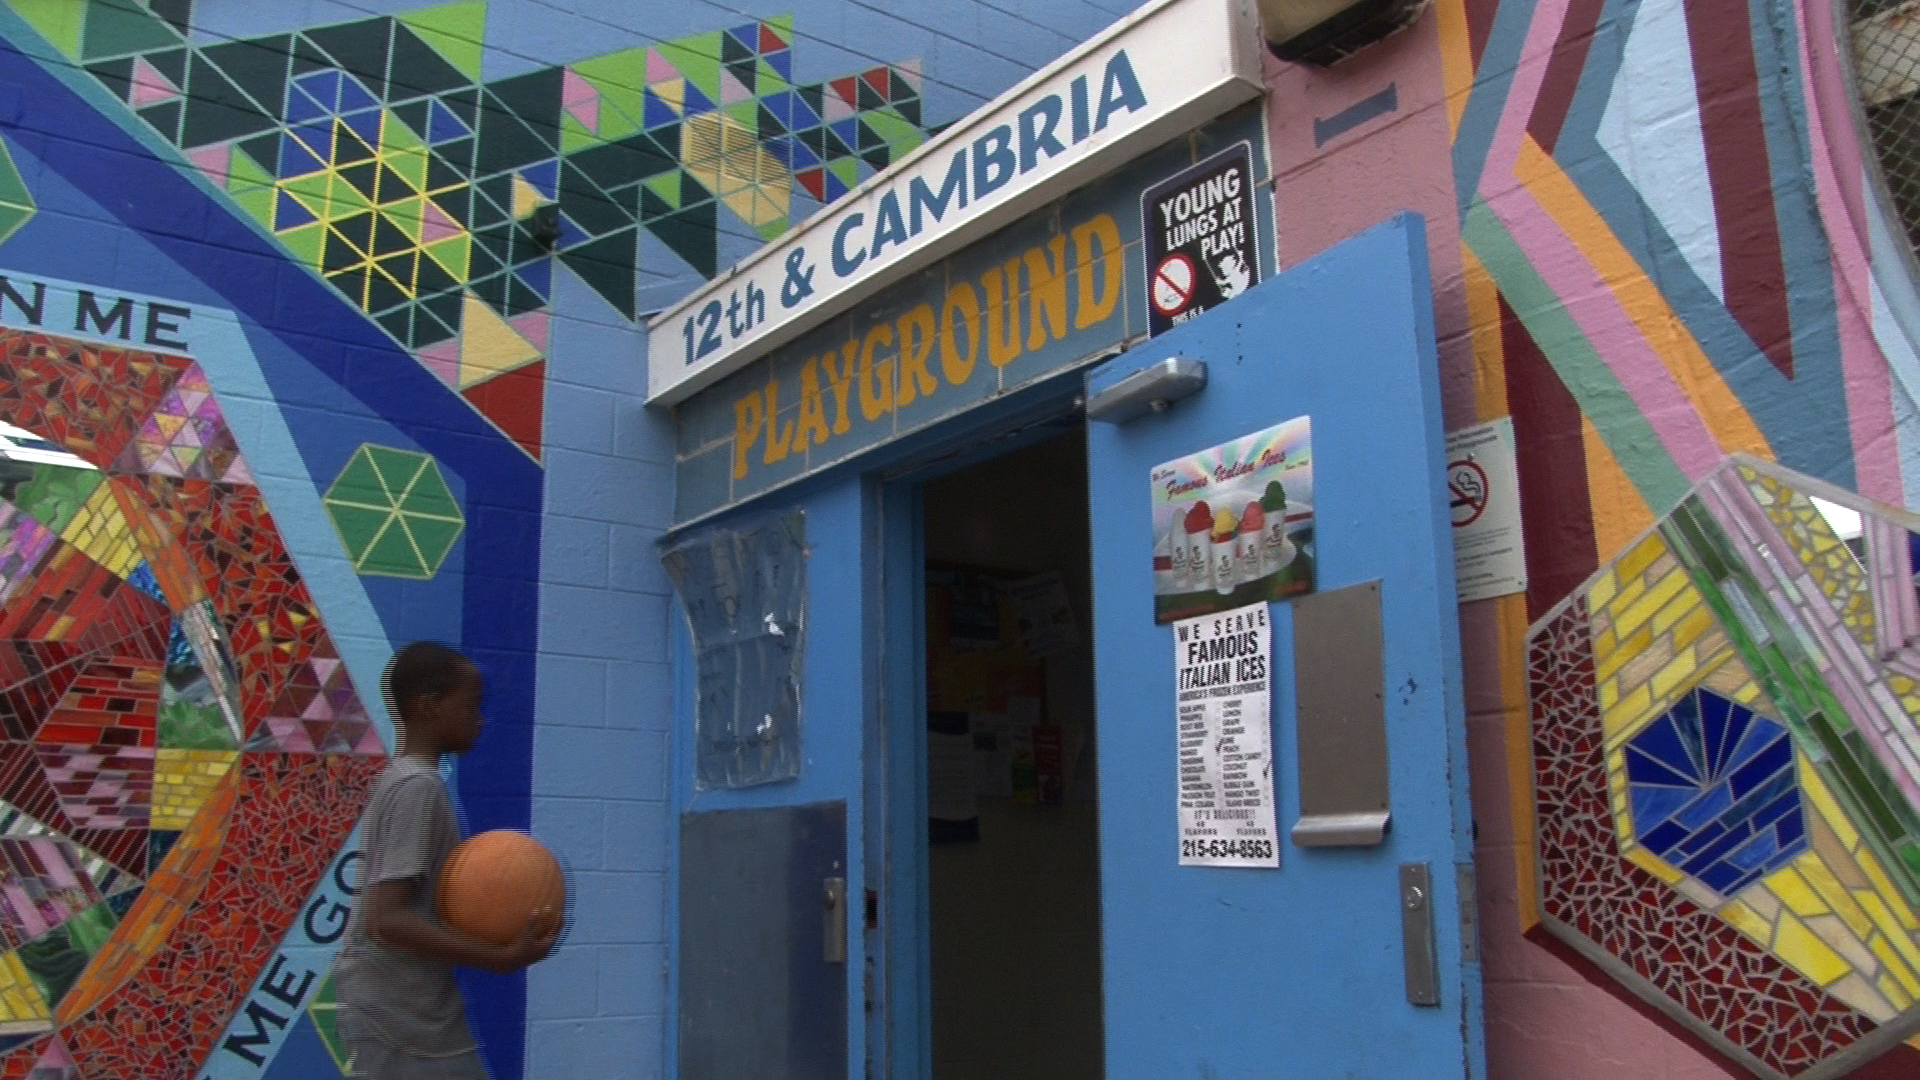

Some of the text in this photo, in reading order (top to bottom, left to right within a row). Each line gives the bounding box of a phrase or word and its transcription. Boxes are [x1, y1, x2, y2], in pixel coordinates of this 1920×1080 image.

[682, 47, 1148, 366] 12th & CAMBRIA
[1160, 168, 1240, 227] YOUNG
[1166, 197, 1243, 252] LUNGS AT
[1201, 222, 1245, 261] PLAY!
[74, 289, 191, 352] ME
[732, 212, 1123, 480] PLAYGROUND
[1166, 449, 1286, 501] Famous Italian Ices
[1178, 623, 1200, 642] WE
[1214, 609, 1265, 636] SERVE
[1187, 630, 1259, 665] FAMOUS
[1180, 655, 1266, 690] ITALIAN ICES
[1182, 839, 1273, 858] 215-634-8563
[222, 953, 317, 1068] ME
